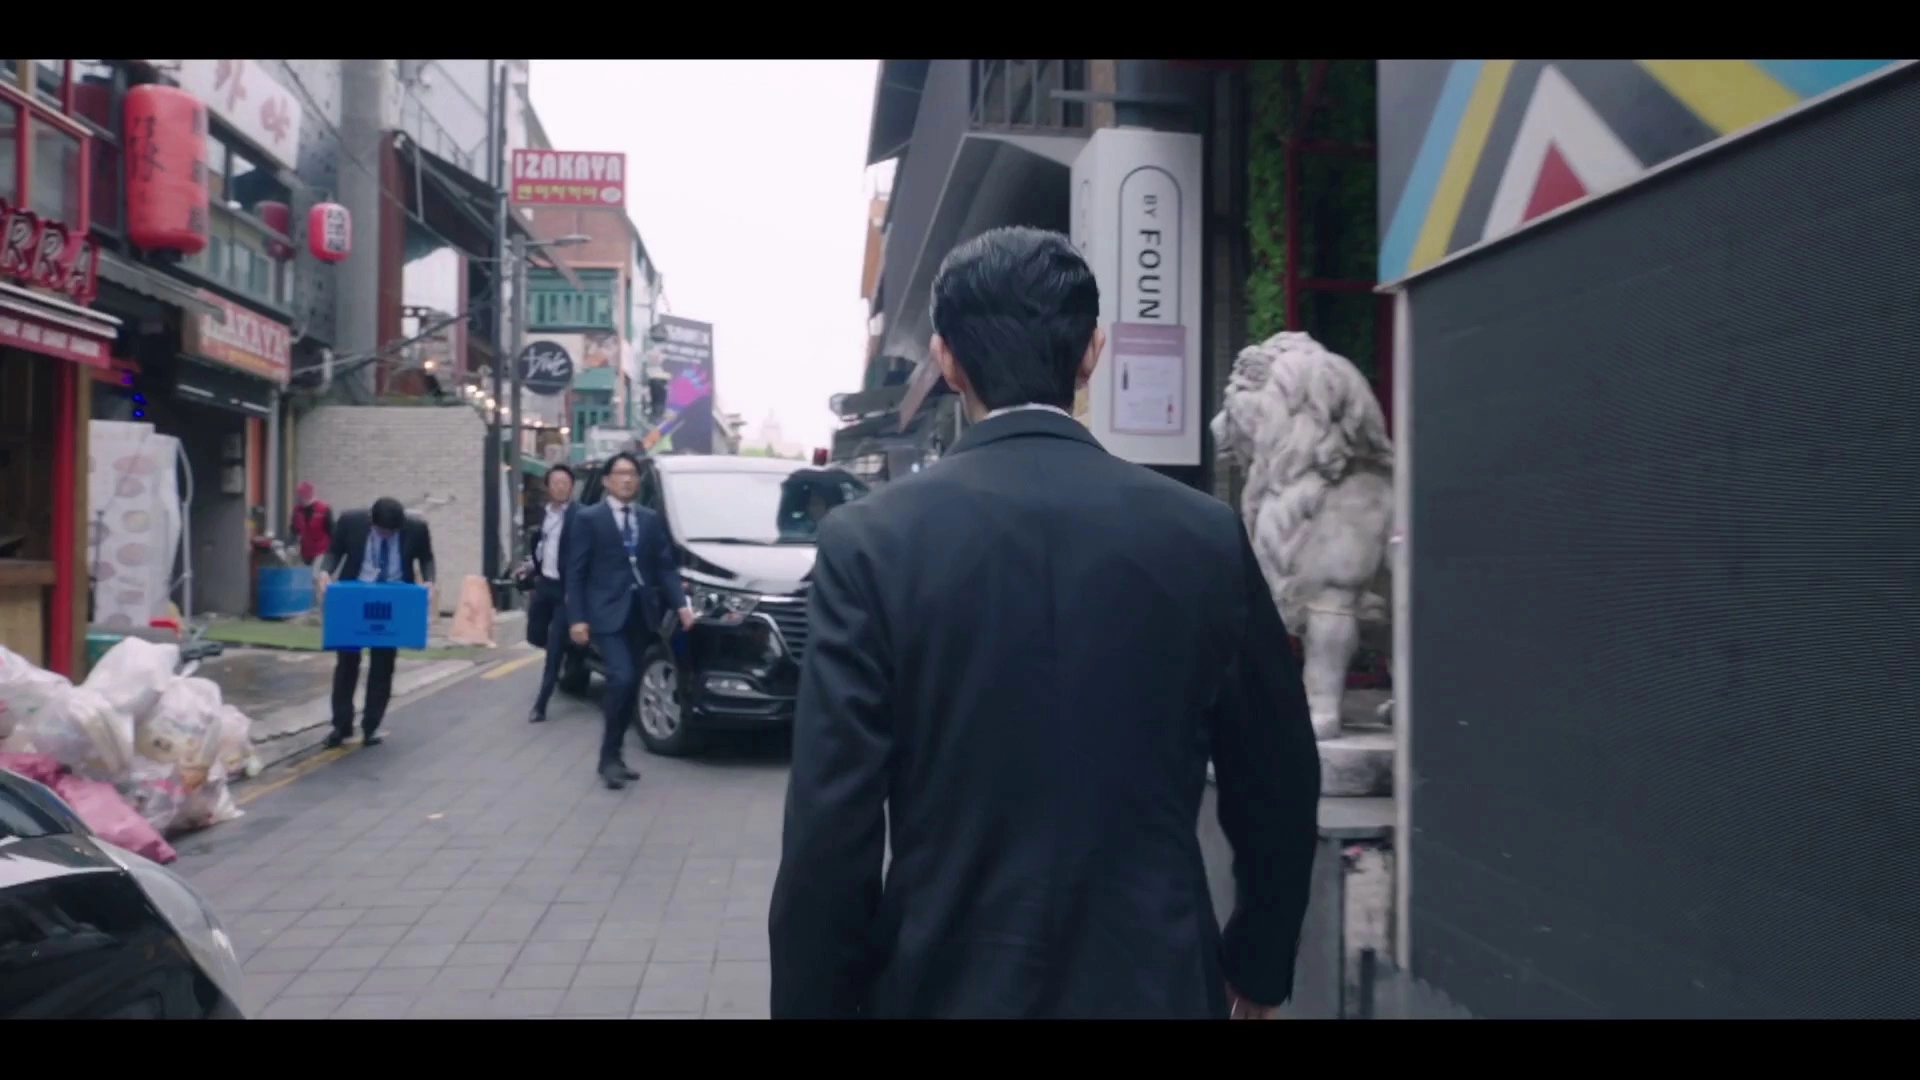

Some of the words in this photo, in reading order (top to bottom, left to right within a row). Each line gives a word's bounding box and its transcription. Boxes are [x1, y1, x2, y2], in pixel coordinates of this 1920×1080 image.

[515, 152, 621, 181] IZAKAYA
[1143, 194, 1157, 218] BY
[1138, 228, 1162, 320] FOUN
